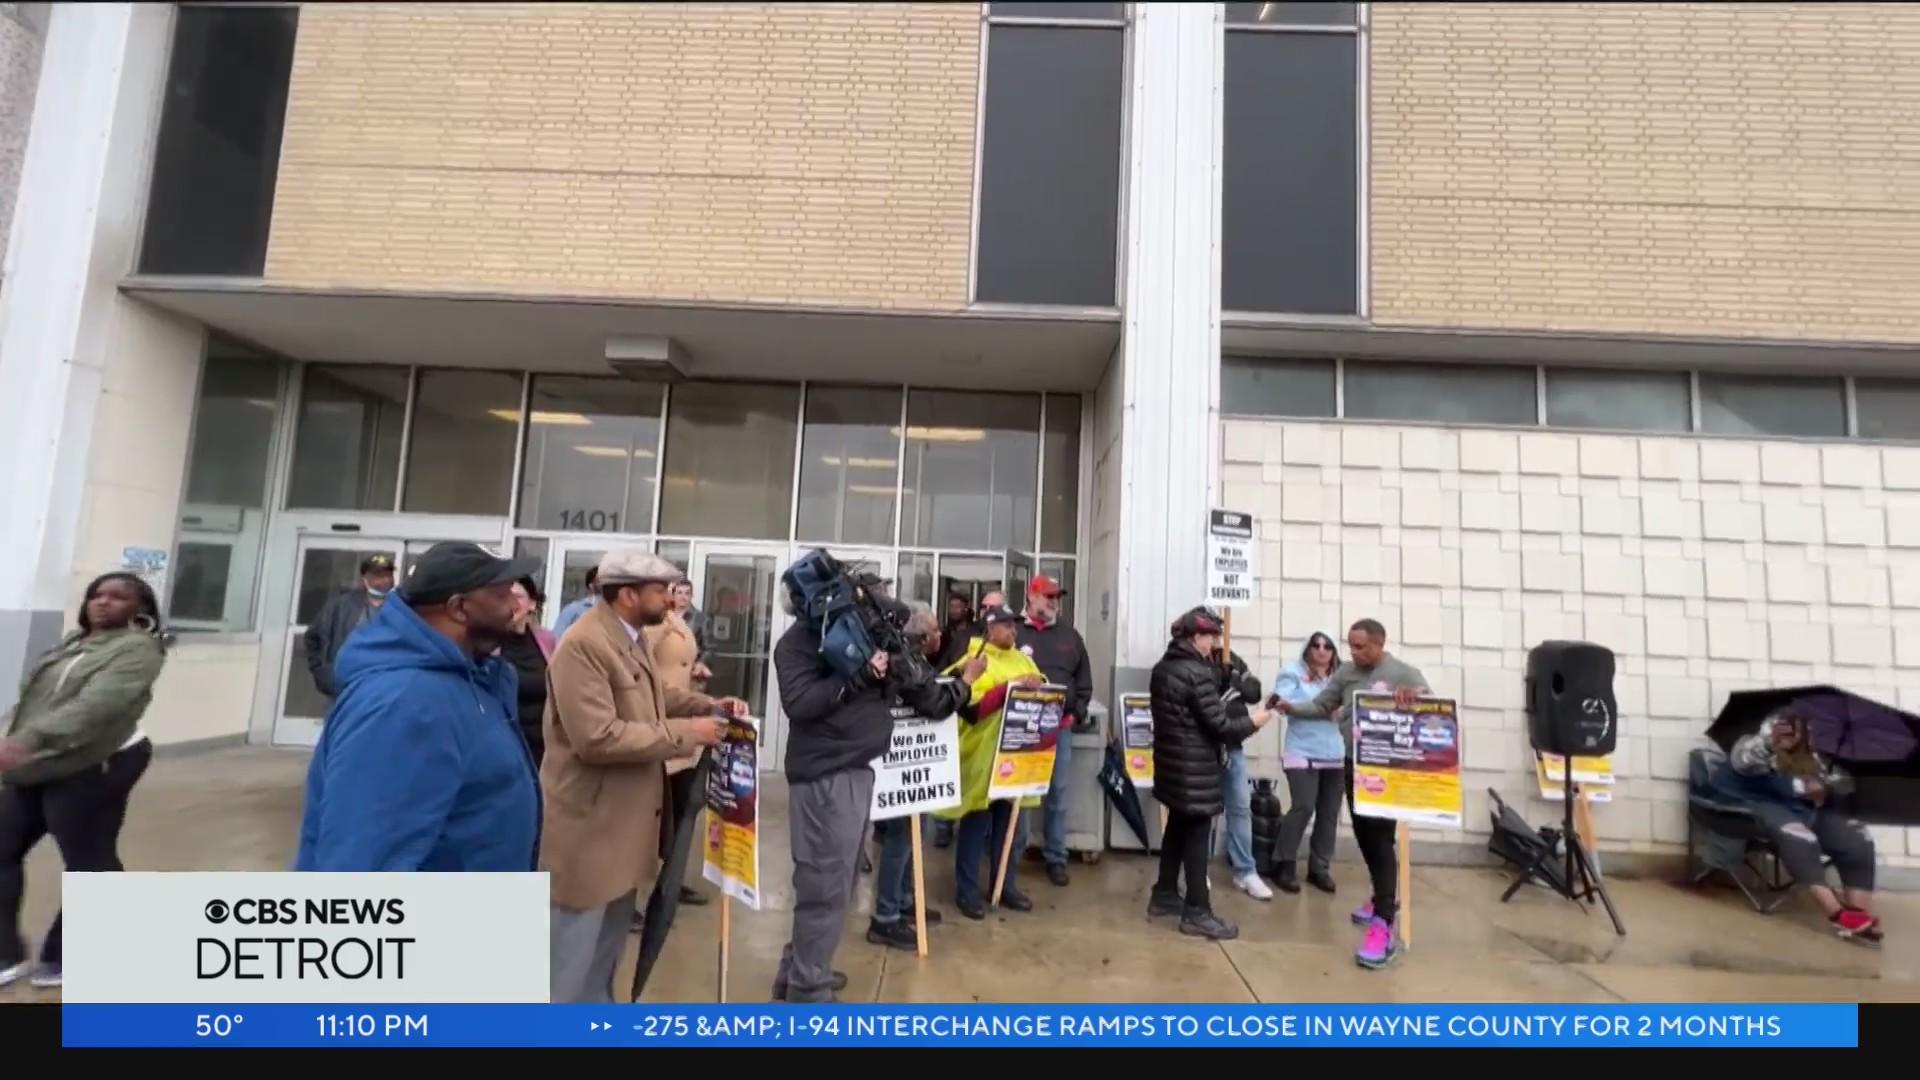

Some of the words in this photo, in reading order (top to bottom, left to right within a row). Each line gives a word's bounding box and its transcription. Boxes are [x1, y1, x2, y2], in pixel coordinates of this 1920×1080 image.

[560, 510, 618, 532] 1401
[1223, 574, 1239, 585] NOT
[1211, 587, 1250, 600] SERVANTS
[893, 735, 913, 747] We
[916, 732, 936, 744] Are
[901, 768, 931, 785] NOT
[878, 782, 955, 808] SERVANTS
